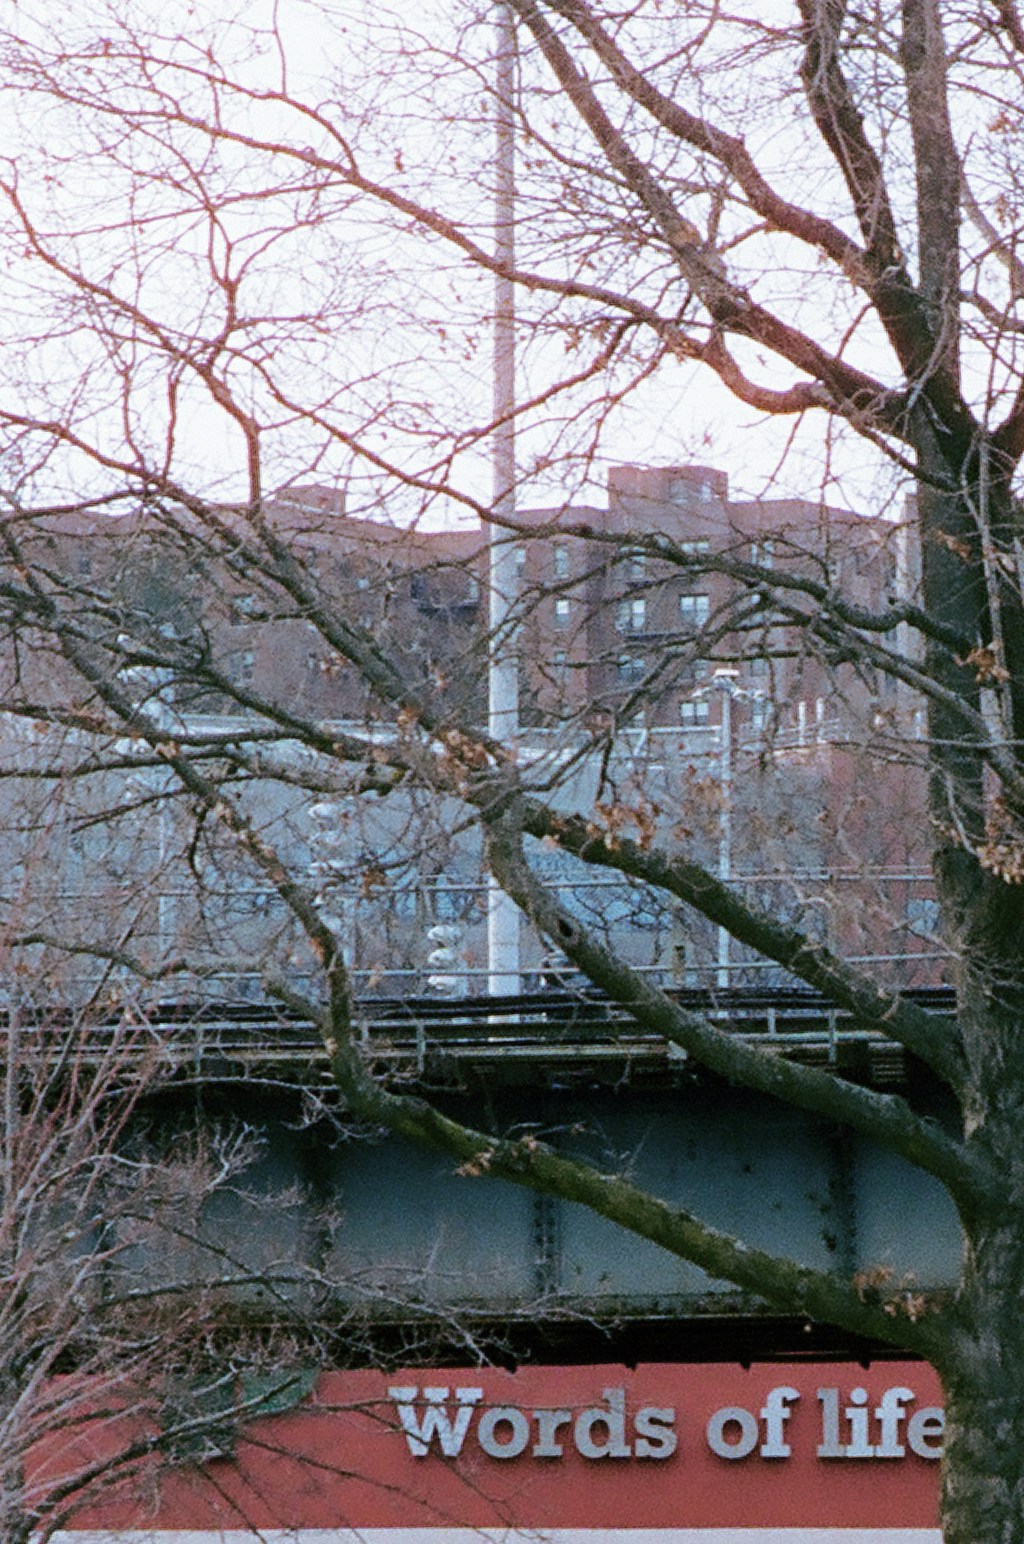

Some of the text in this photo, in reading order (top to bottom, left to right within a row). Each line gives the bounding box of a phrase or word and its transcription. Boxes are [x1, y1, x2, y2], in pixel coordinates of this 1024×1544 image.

[388, 1387, 946, 1459] Words of life
